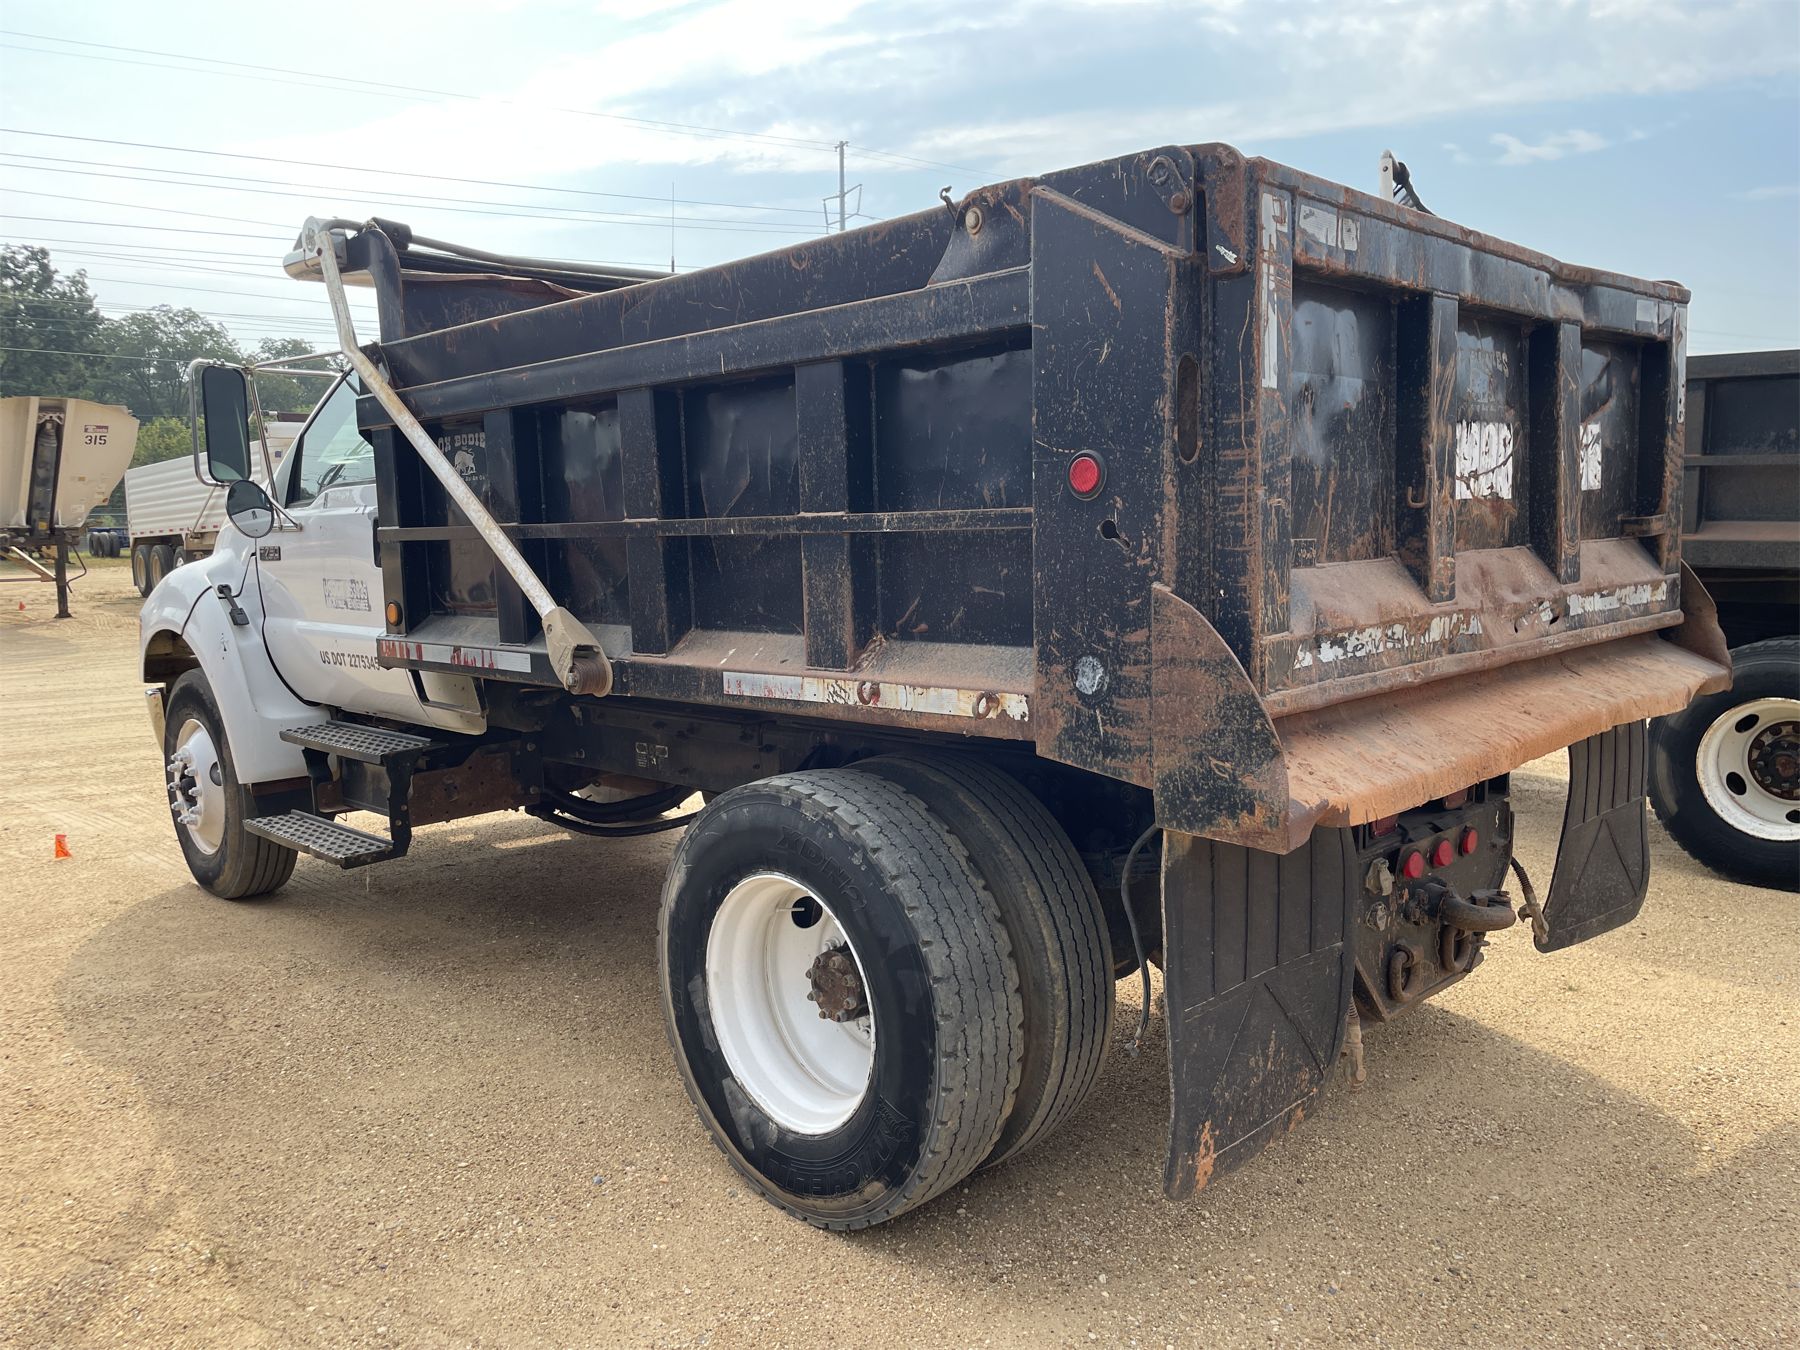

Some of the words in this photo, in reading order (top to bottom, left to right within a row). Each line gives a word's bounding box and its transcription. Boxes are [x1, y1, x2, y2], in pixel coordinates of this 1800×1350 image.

[84, 435, 107, 446] 315
[319, 650, 331, 665] US
[331, 651, 347, 667] DOT
[348, 653, 380, 671] 2275345
